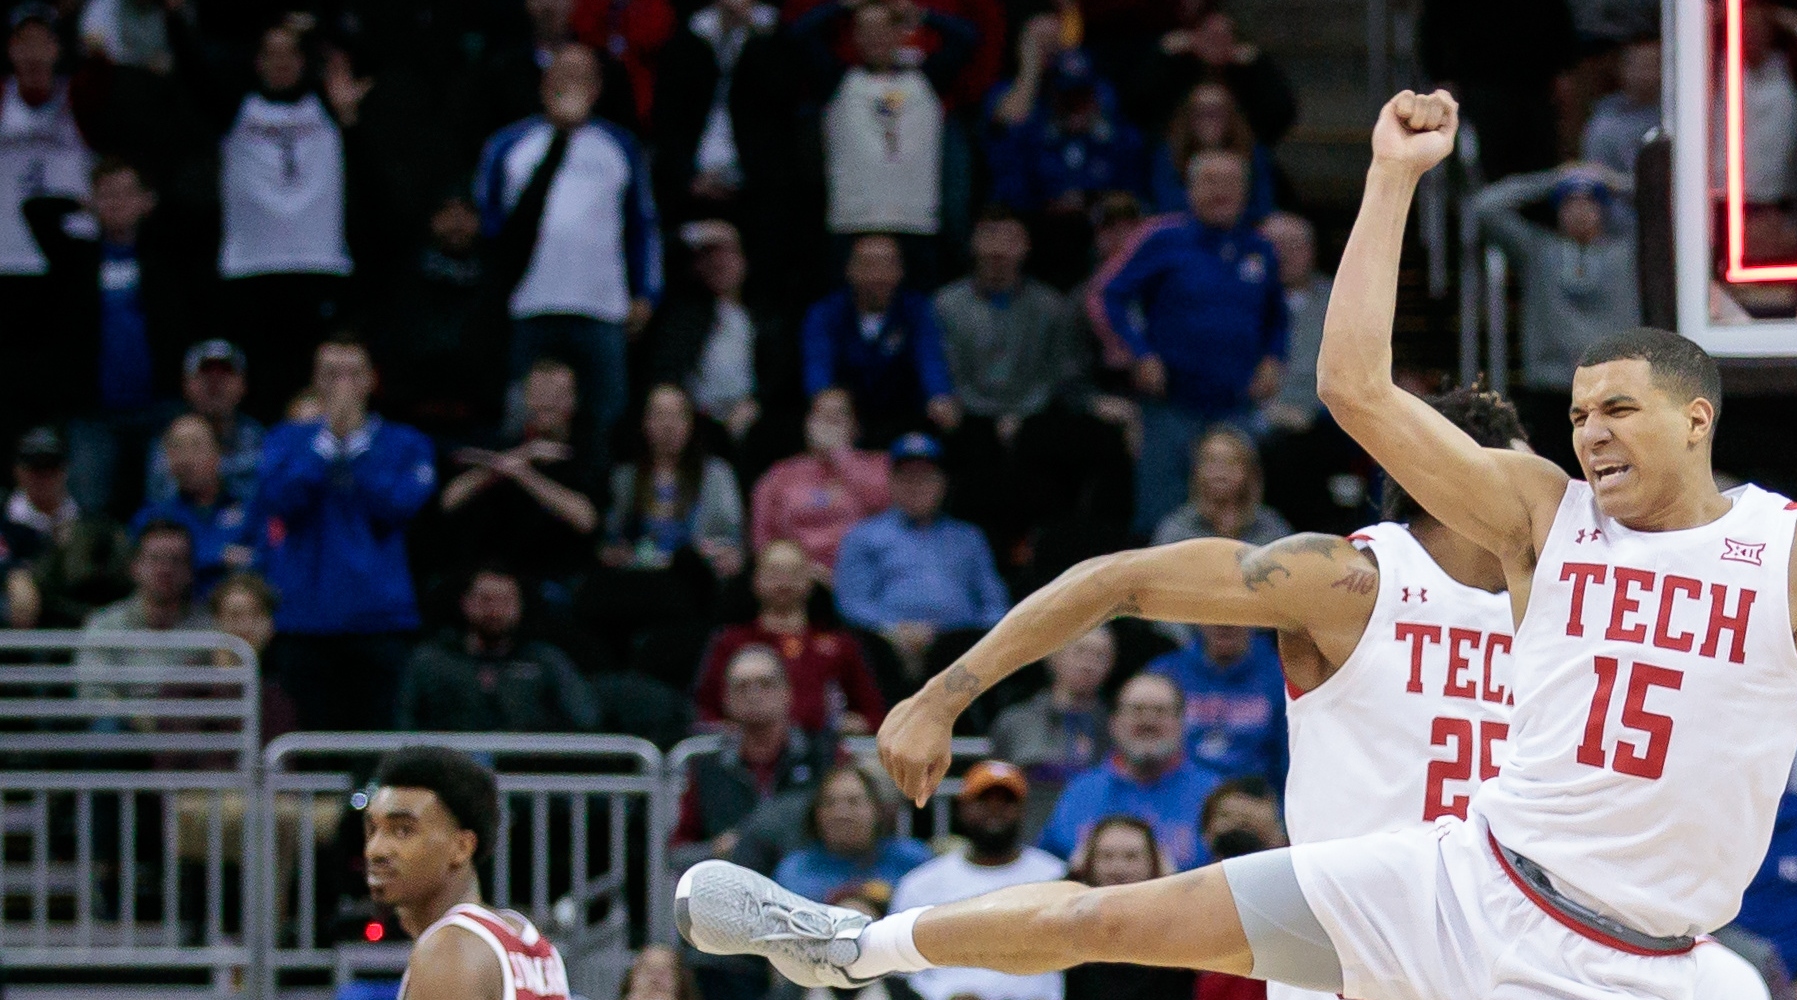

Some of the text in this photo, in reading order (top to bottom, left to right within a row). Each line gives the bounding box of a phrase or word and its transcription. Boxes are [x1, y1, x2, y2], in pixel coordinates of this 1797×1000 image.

[1395, 622, 1515, 706] TEC
[1559, 562, 1757, 664] TECH
[1576, 655, 1685, 780] 15
